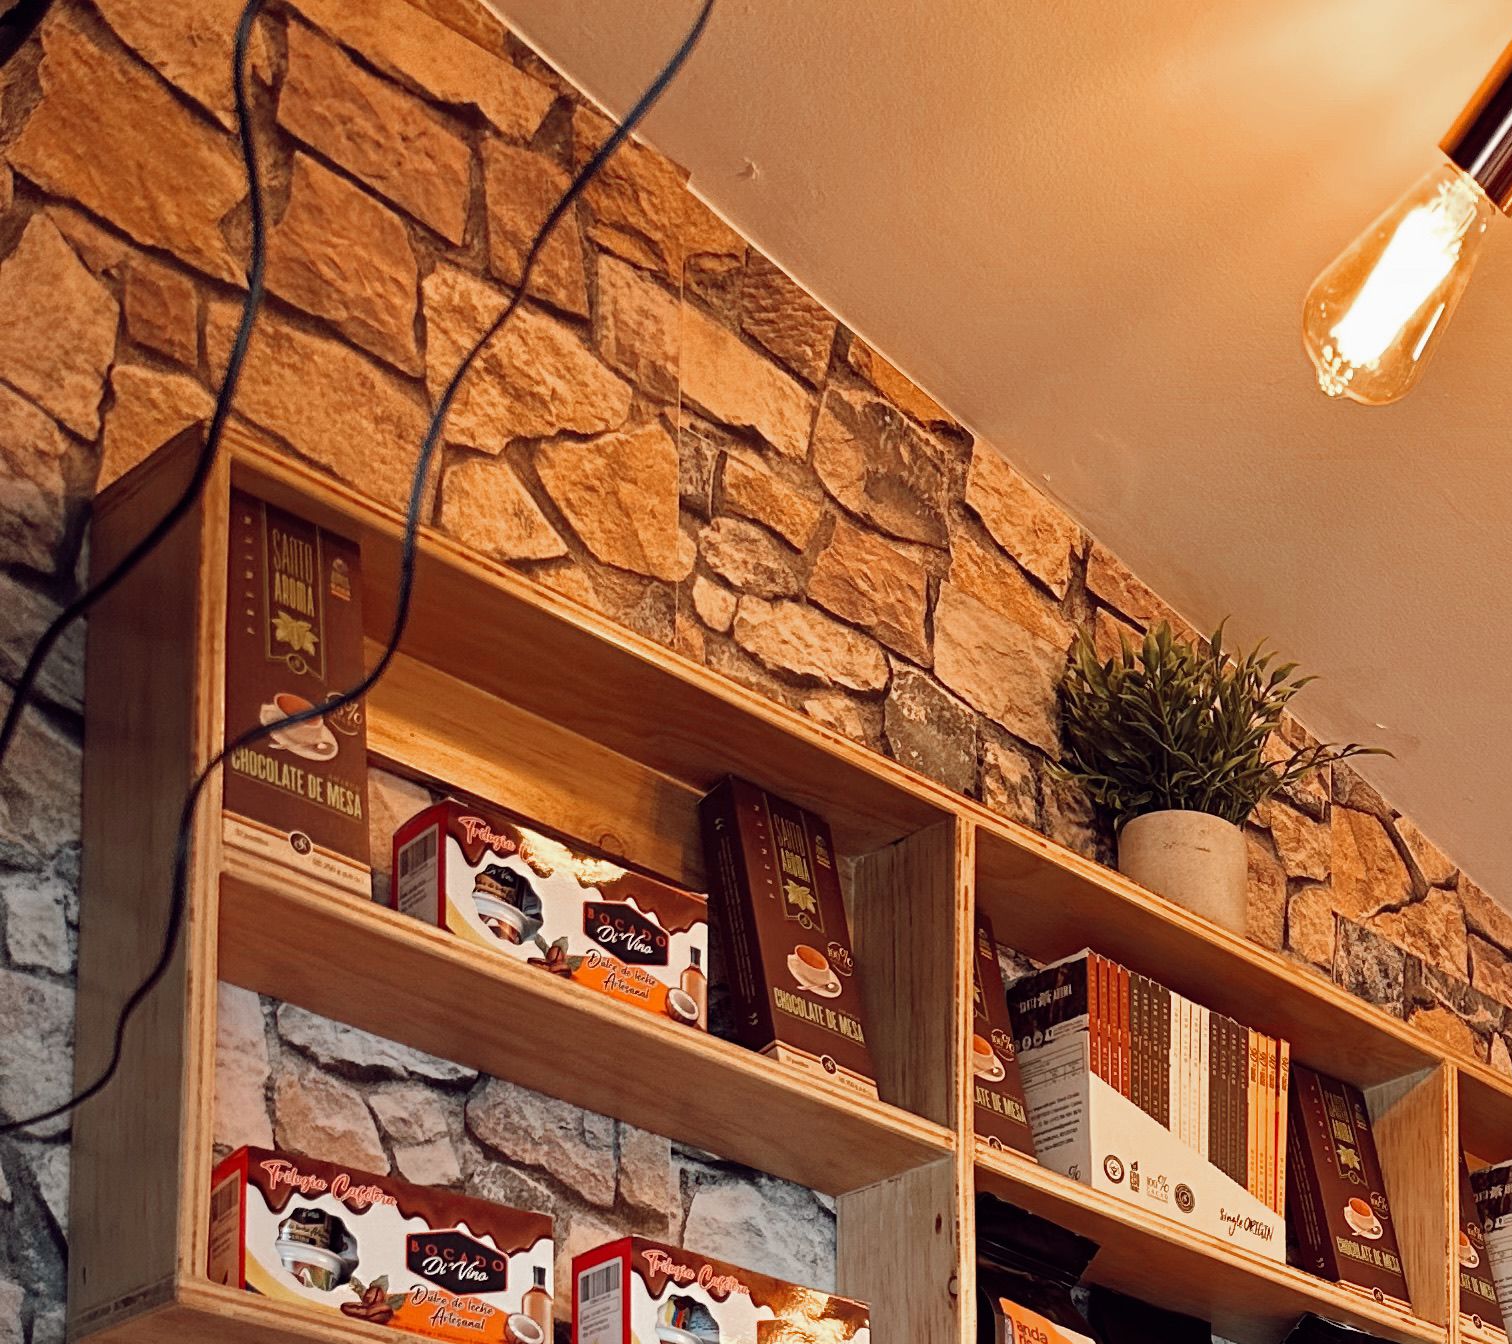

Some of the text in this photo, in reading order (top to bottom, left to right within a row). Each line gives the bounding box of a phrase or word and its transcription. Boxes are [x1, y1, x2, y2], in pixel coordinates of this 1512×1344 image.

[231, 746, 304, 796] CHOCOLATE
[307, 773, 324, 802] DE
[326, 781, 362, 820] MESA
[587, 907, 667, 947] BOCADO
[773, 986, 826, 1027] CHOCOLATE
[826, 1008, 839, 1031] DE
[1219, 1207, 1243, 1237] Single
[410, 1239, 505, 1272] BOCADO
[429, 1306, 486, 1331] Artesanal
[451, 1296, 463, 1310] de
[1016, 1320, 1049, 1344] anda
